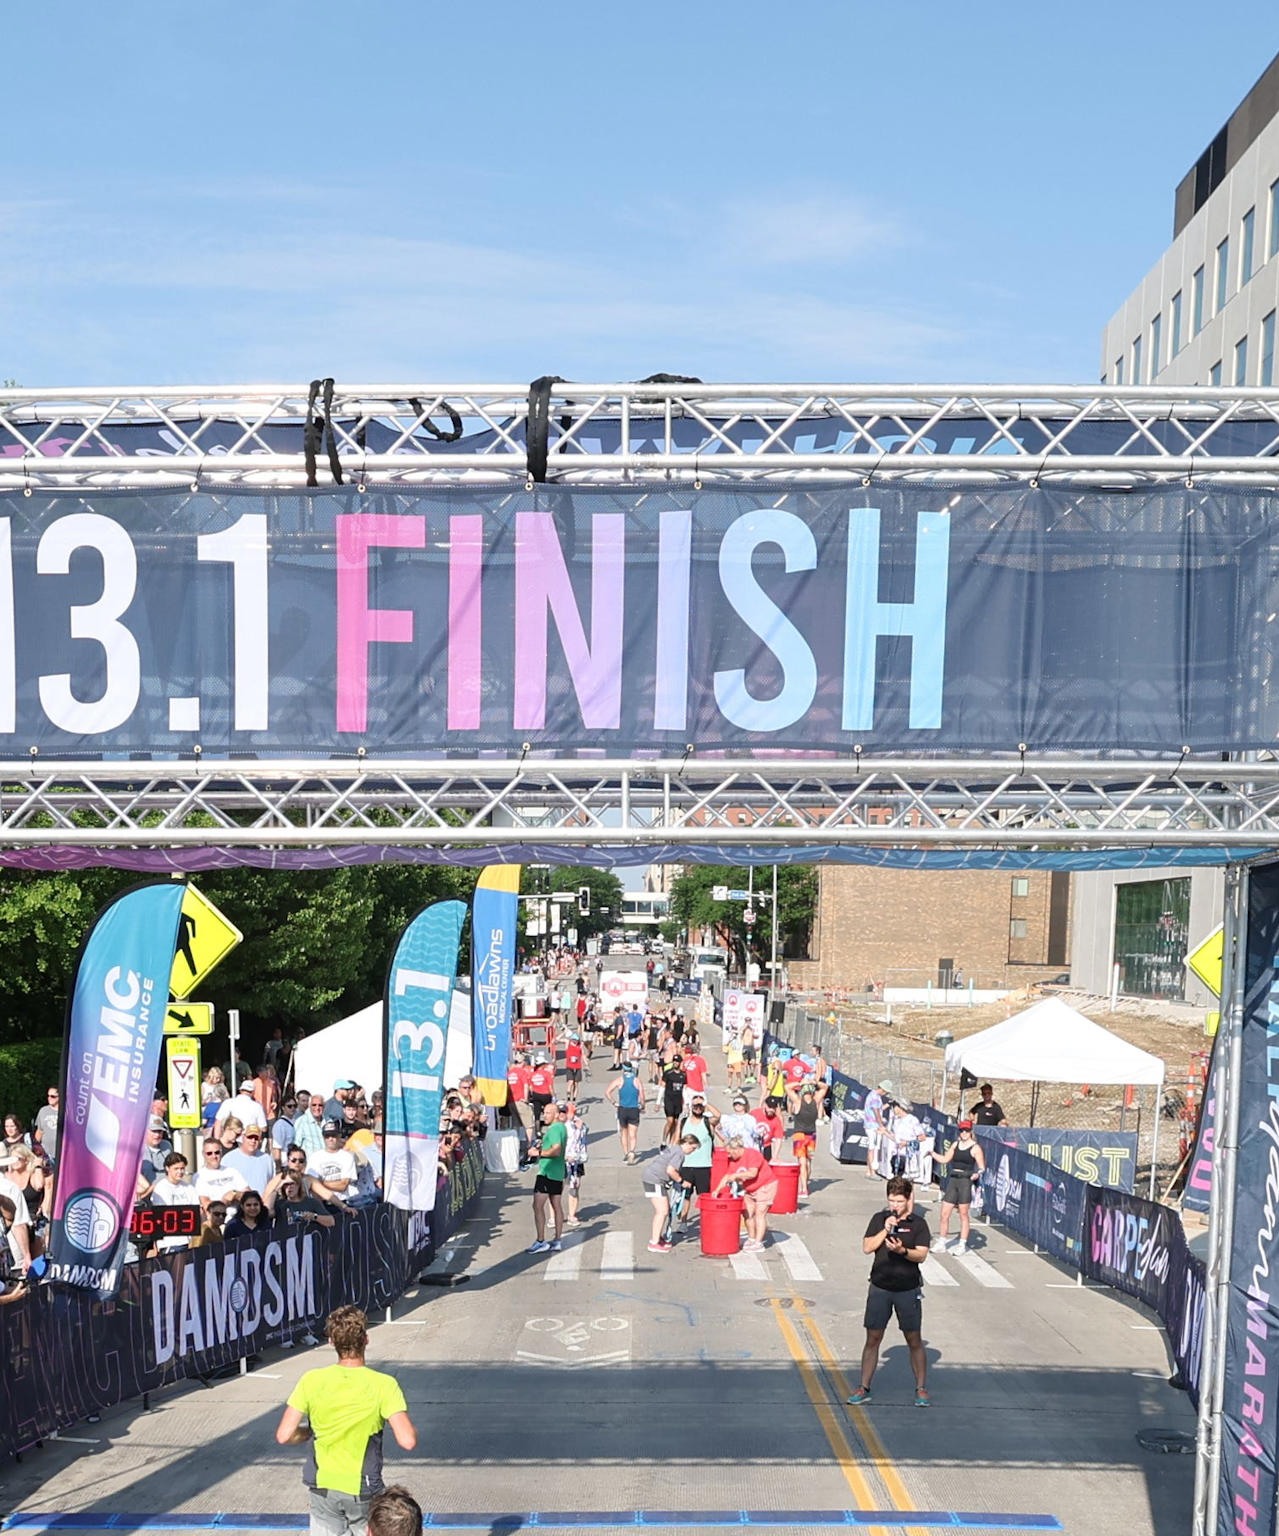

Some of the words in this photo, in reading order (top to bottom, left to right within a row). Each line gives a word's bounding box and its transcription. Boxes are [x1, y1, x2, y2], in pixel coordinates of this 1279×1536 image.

[336, 508, 951, 734] FINISH
[82, 1053, 94, 1074] on
[92, 965, 141, 1099] EMC
[128, 977, 155, 1104] INSURANCE
[392, 968, 451, 1098] 13.1
[76, 1079, 90, 1126] count
[1090, 1203, 1149, 1280] CARPE
